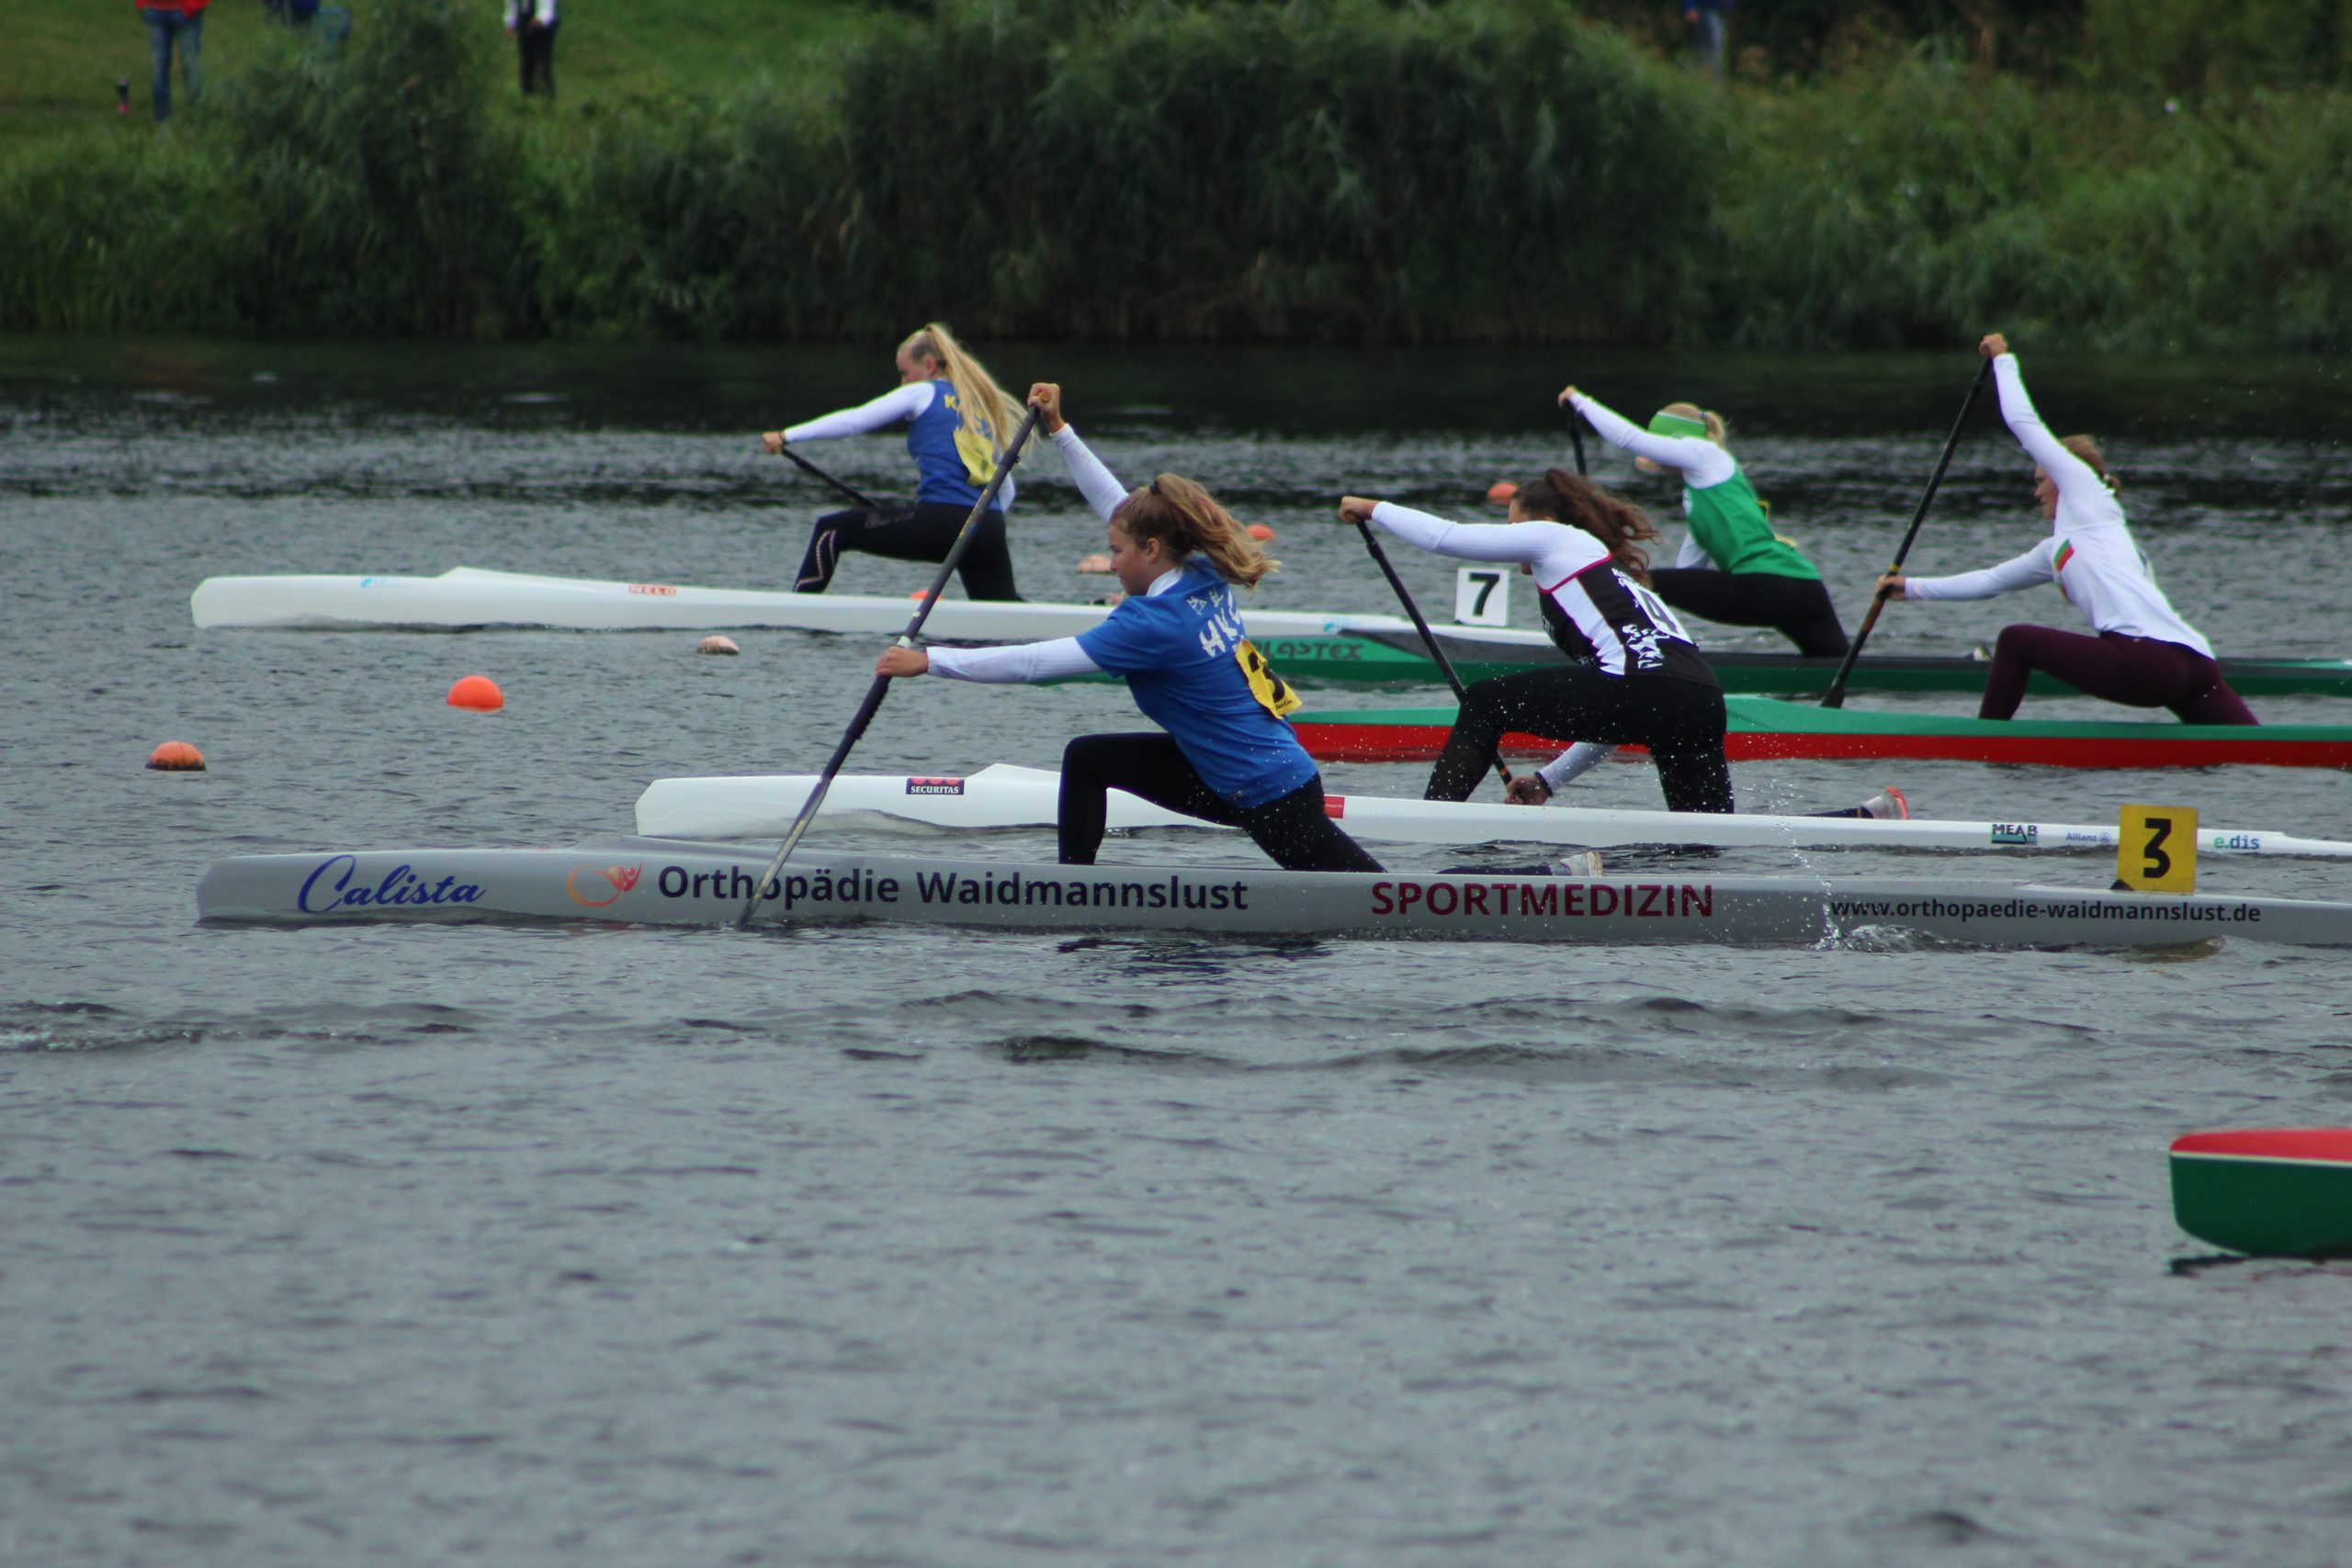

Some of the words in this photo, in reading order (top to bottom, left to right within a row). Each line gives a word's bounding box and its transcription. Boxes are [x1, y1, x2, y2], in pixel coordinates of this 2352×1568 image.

[1469, 572, 1499, 616] 7
[910, 785, 959, 795] SECURITAS
[1992, 824, 2038, 838] MEAB
[2065, 832, 2098, 842] Allianz
[2214, 835, 2260, 850] e.dis
[2143, 818, 2172, 878] 3
[298, 854, 487, 913] Calista
[658, 865, 899, 910] Orthopädie
[915, 871, 1249, 910] Waidmannslust
[1371, 881, 1713, 918] SPORTMEDIZIN
[1830, 897, 2262, 922] www.orthopaedie-waidmannslust.de
